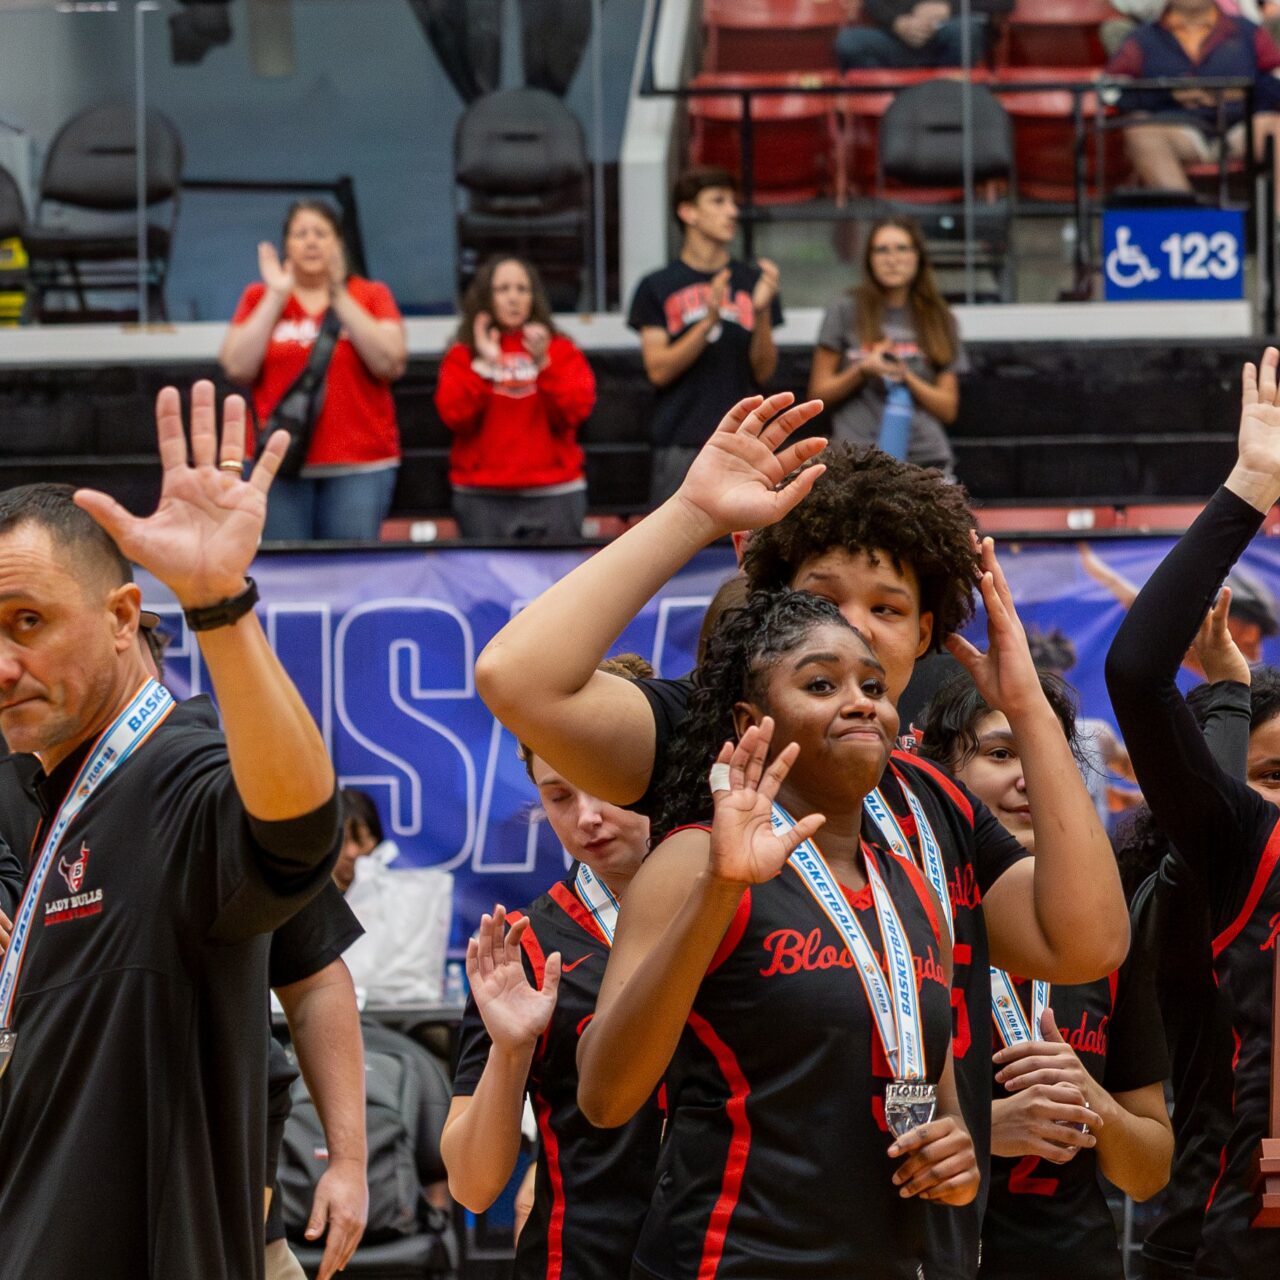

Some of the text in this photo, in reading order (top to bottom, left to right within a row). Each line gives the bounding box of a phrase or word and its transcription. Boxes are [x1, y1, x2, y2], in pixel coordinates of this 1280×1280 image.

[1160, 231, 1240, 280] 123
[127, 685, 168, 733] BASKE
[45, 897, 69, 915] LADY
[796, 842, 859, 942] ASKETBALL
[882, 909, 912, 1017] BASKETBALL
[871, 978, 889, 1014] FLORIDA
[1005, 1009, 1023, 1041] FLORIDA
[904, 1031, 912, 1066] FLORIDA
